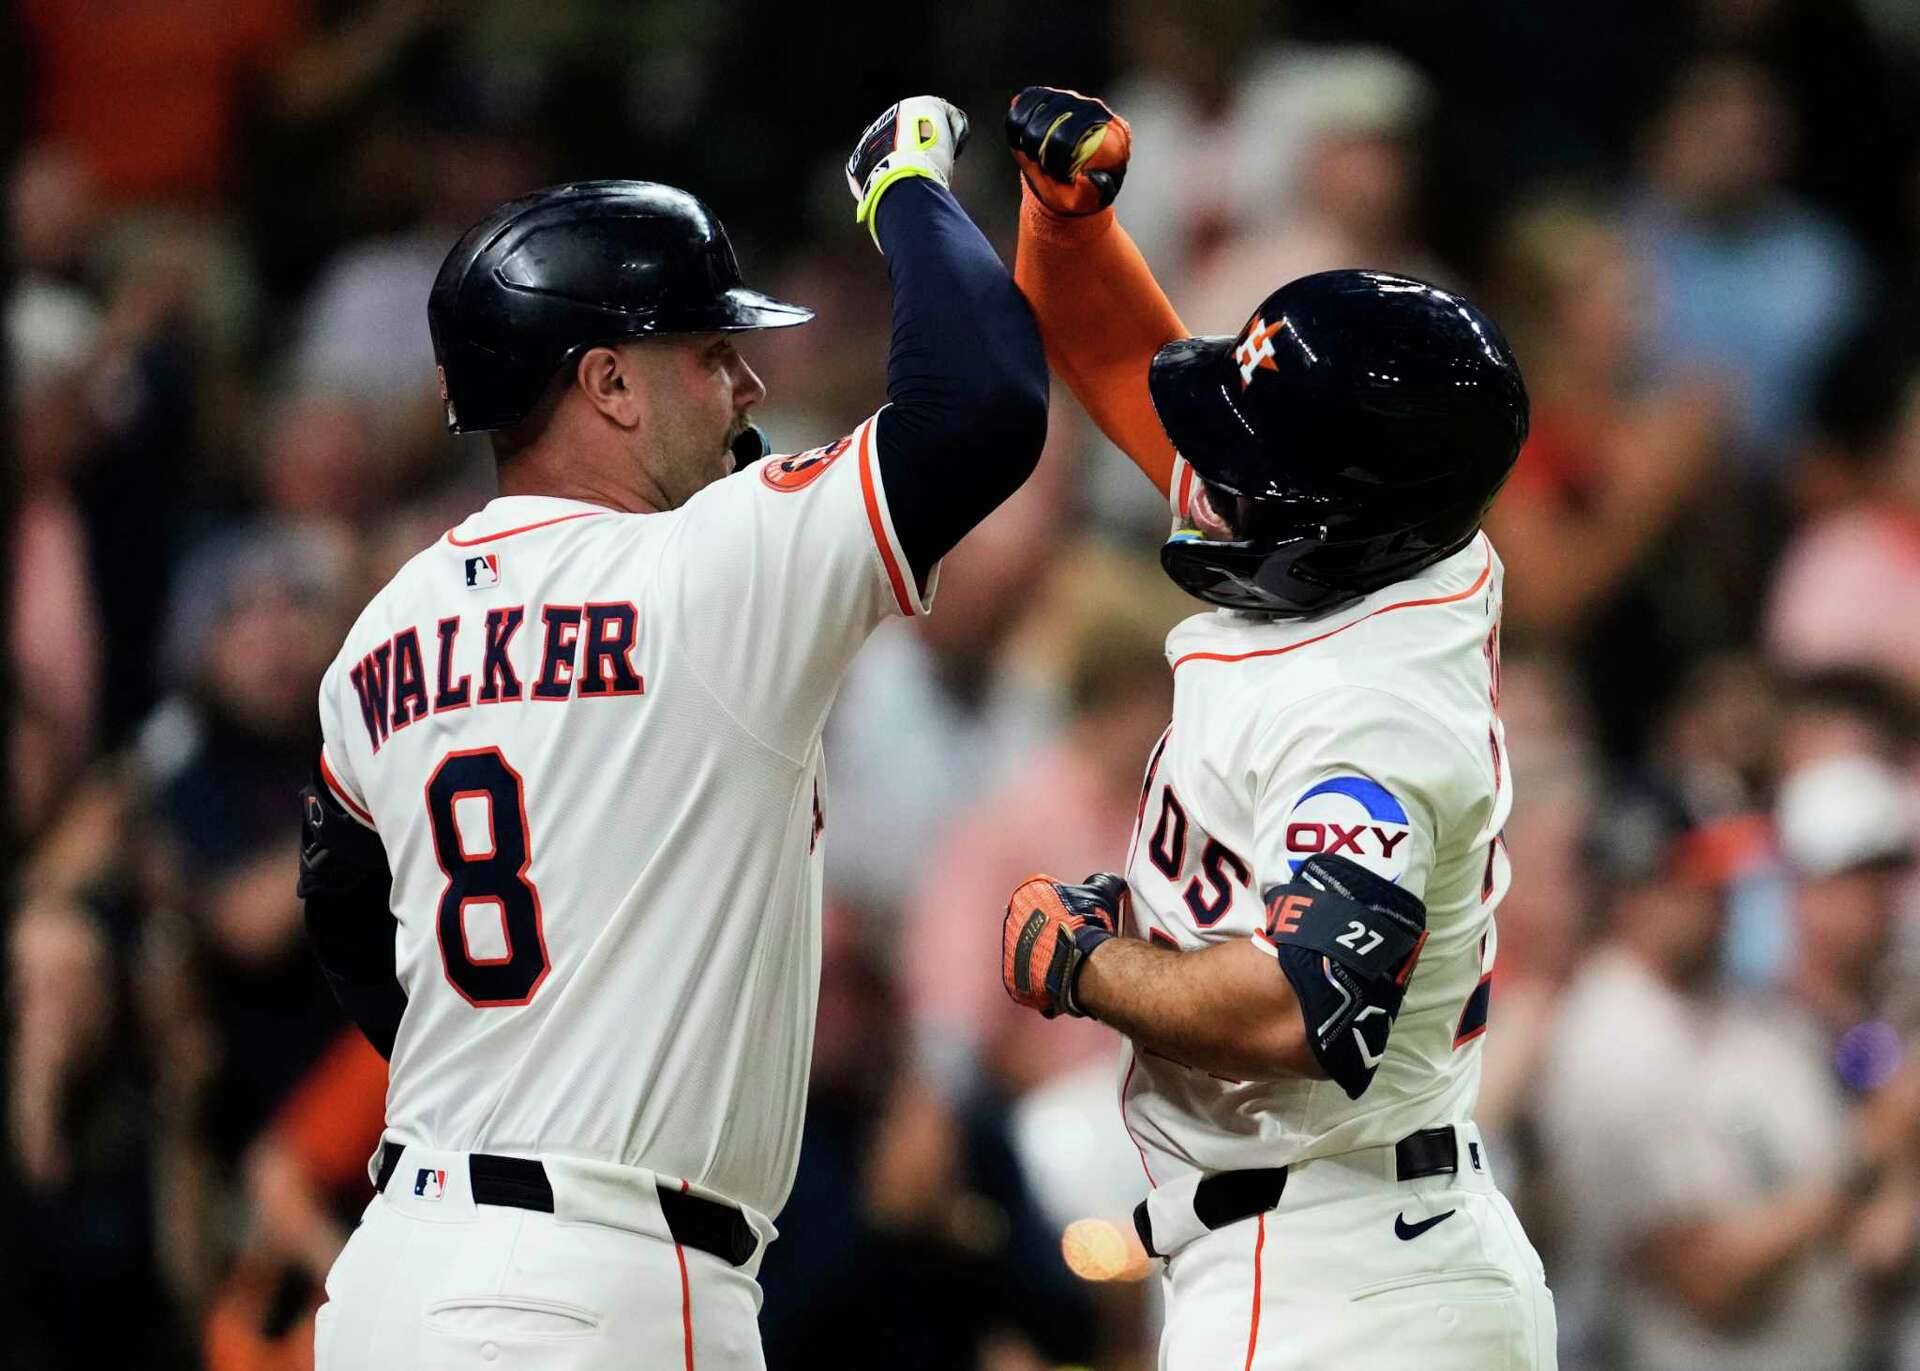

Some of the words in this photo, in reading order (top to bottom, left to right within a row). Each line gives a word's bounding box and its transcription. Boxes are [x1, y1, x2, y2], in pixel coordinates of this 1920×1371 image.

[350, 601, 644, 754] WALKER
[425, 746, 551, 1008] 8
[1286, 823, 1409, 859] OXY
[1336, 921, 1384, 956] 27
